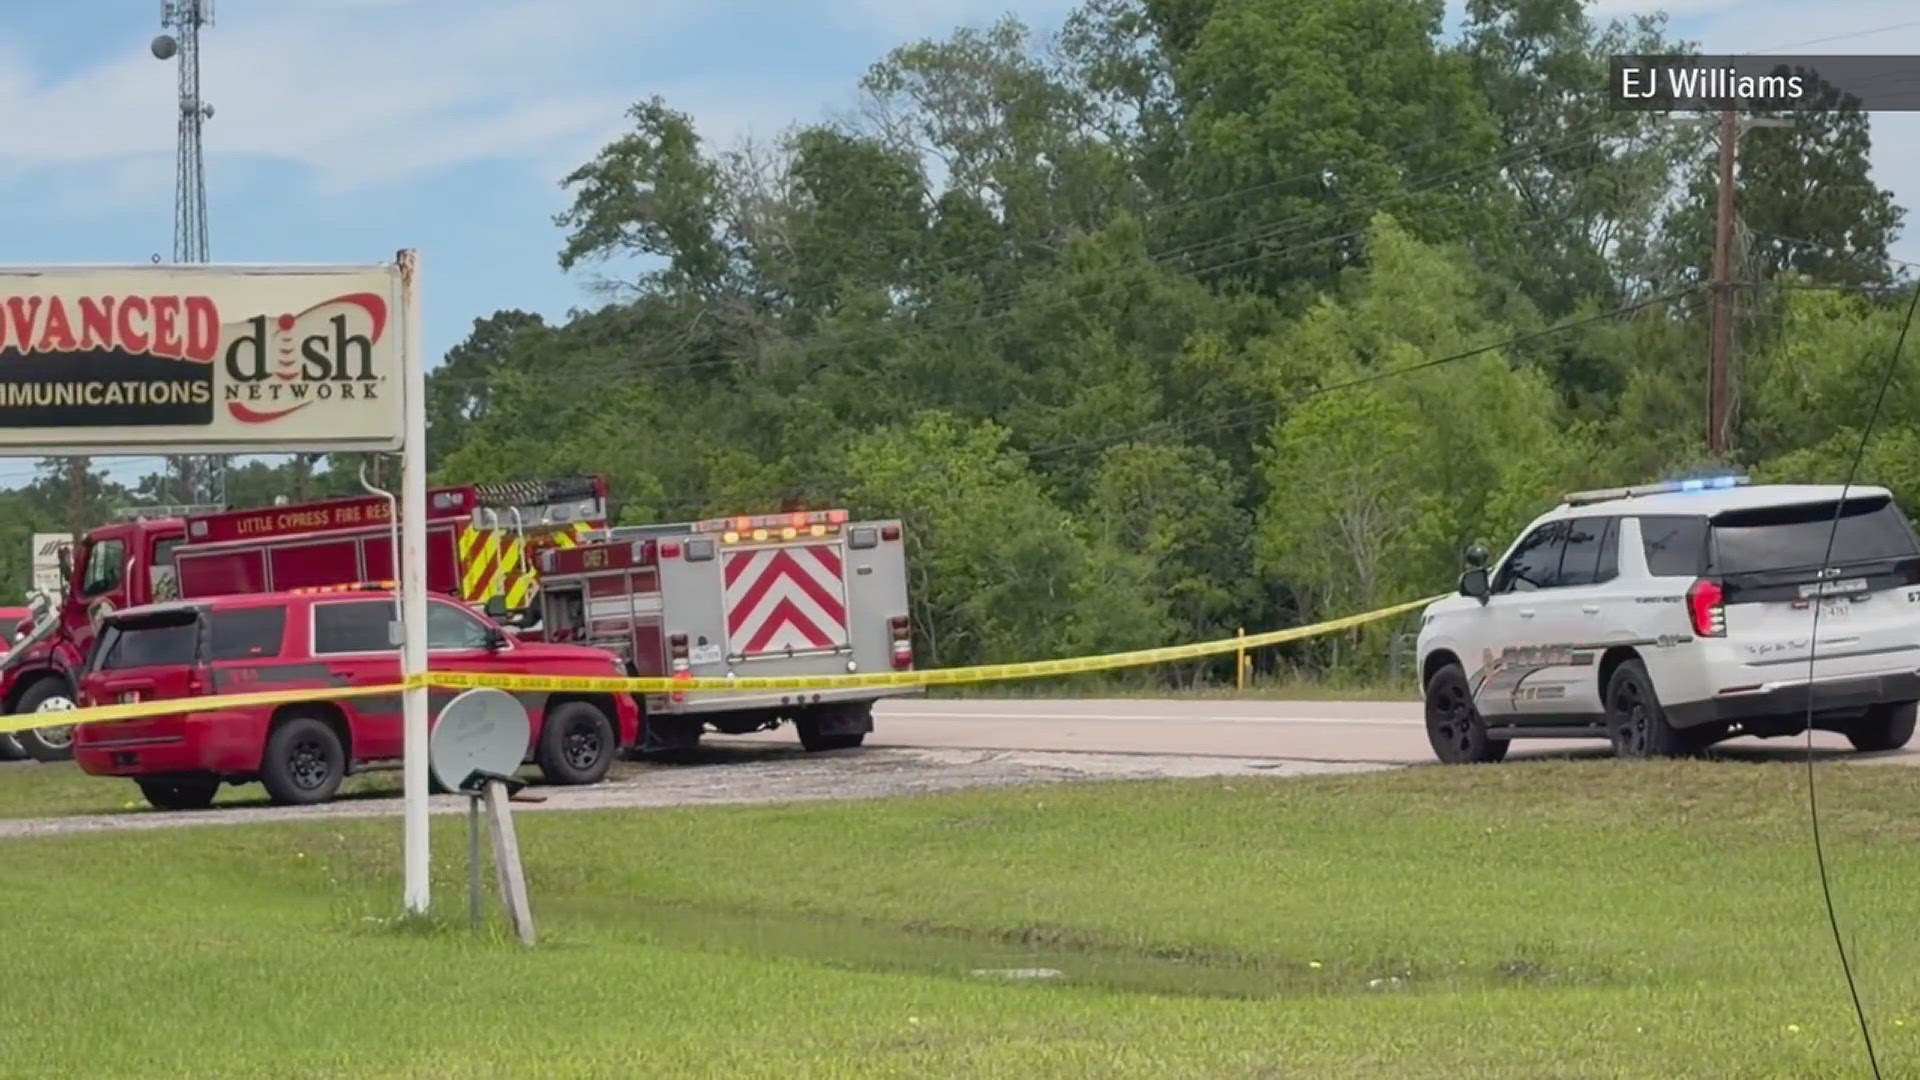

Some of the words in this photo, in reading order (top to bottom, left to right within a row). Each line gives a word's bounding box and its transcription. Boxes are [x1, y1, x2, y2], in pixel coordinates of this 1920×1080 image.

[0, 294, 219, 363] VANCED
[225, 313, 378, 382] dish
[0, 381, 210, 406] MUNICATIONS
[225, 383, 378, 400] NETWORK
[237, 515, 273, 534] LITTLE
[277, 509, 330, 530] CYPRESS
[335, 505, 361, 523] FIRE
